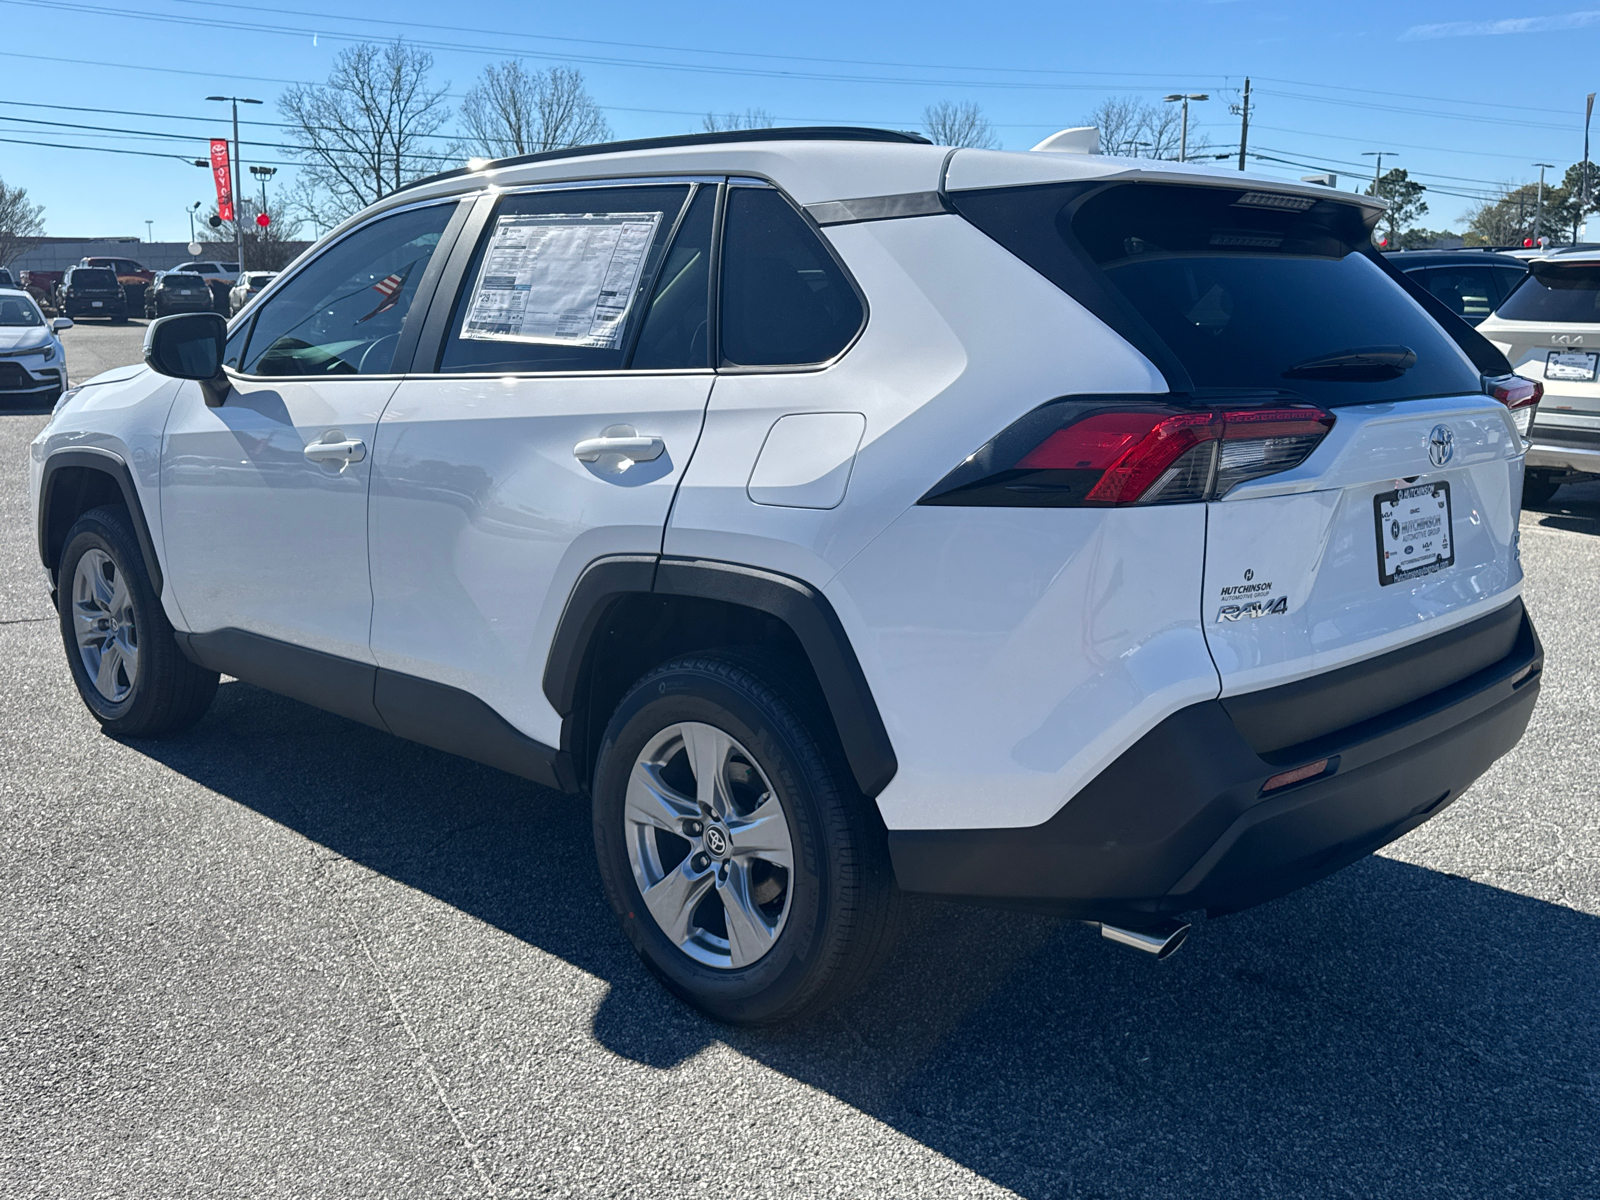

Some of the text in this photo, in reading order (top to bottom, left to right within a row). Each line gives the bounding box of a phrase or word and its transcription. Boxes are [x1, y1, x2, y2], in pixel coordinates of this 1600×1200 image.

[215, 156, 230, 217] OYOA
[1551, 334, 1584, 345] KIA
[1401, 514, 1441, 534] HUTCHINSON
[1402, 527, 1441, 542] AUTOMOTIVE GROUP
[1220, 582, 1273, 596] HUTCHINSON
[1221, 590, 1270, 602] AUTOMOTIVE GROUP
[1214, 595, 1289, 624] RAV4
